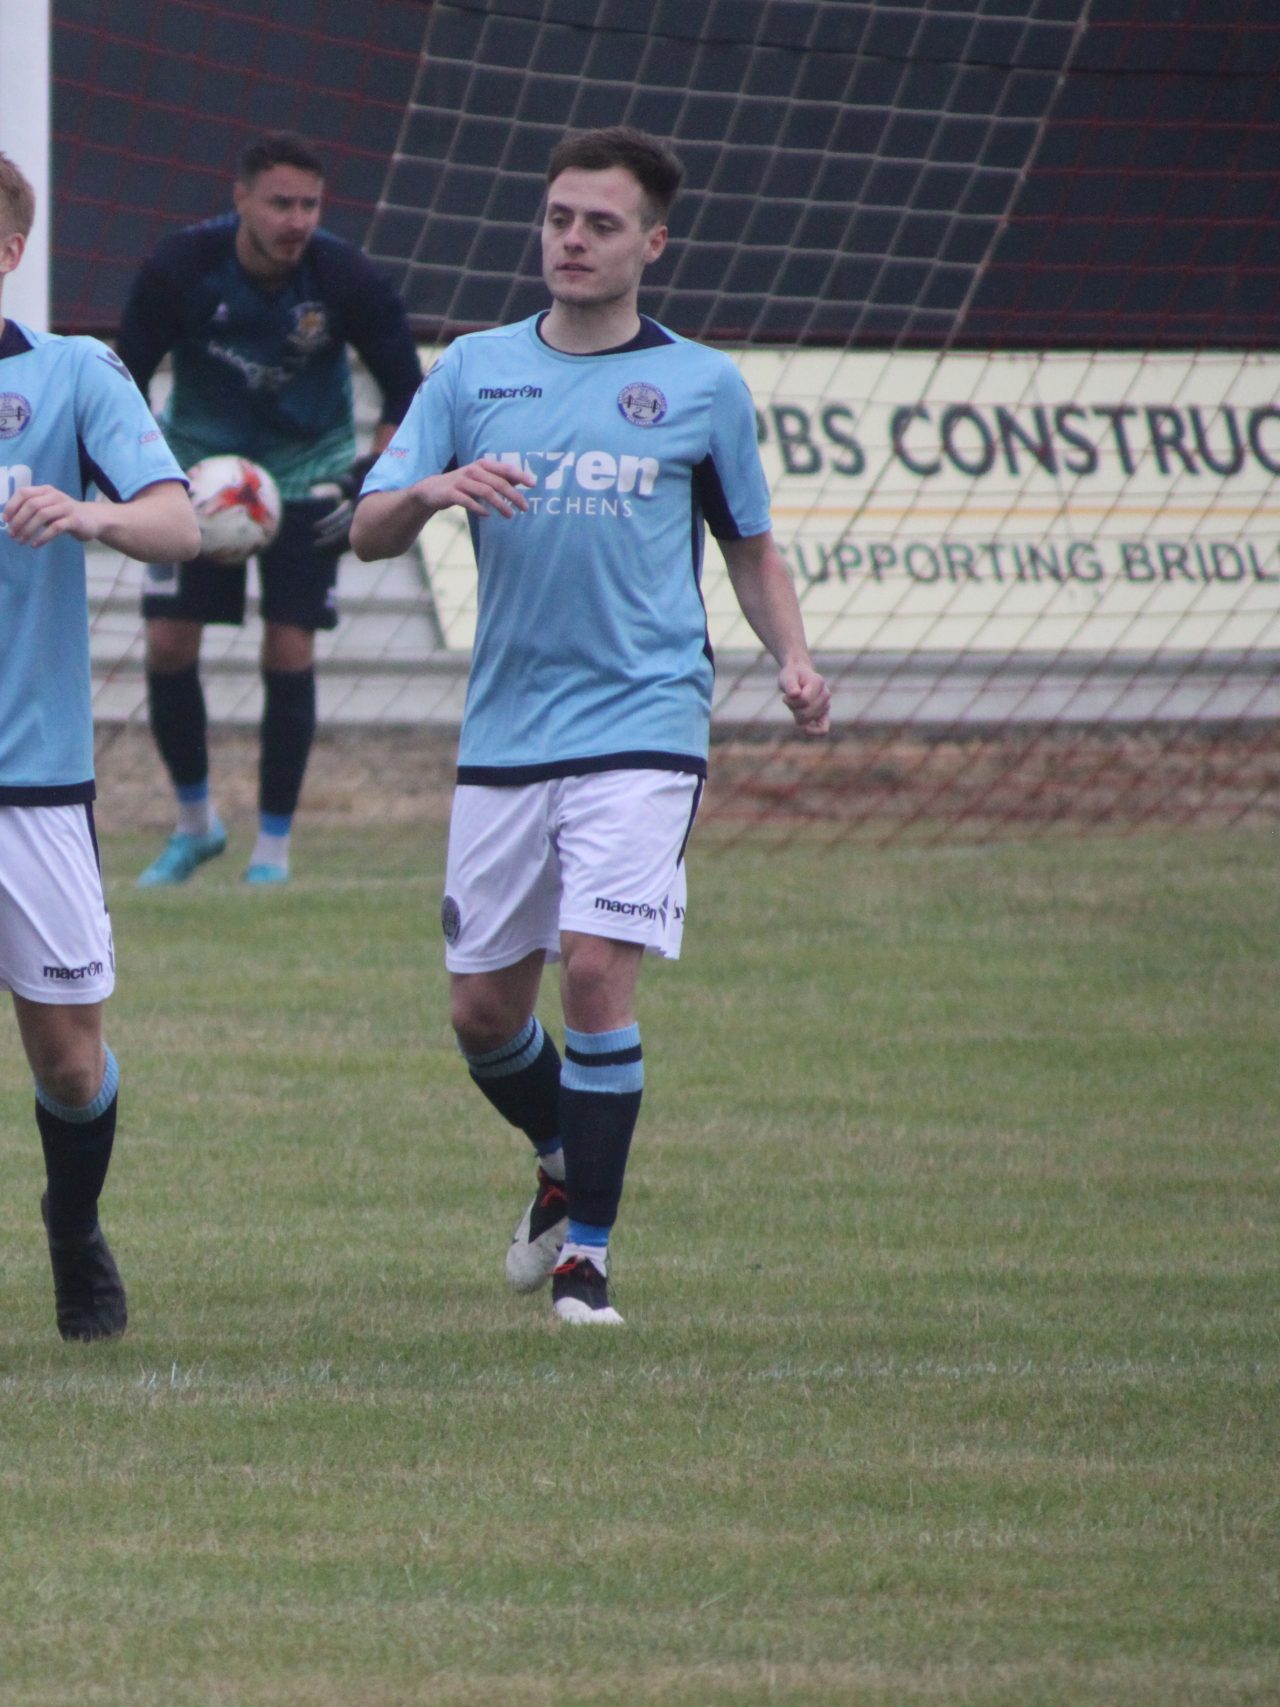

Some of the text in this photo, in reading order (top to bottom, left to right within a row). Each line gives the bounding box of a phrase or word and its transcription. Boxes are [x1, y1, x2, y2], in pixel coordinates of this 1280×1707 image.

[478, 385, 543, 400] macron
[756, 404, 866, 477] BS
[504, 496, 634, 518] TCHENS
[43, 961, 103, 980] macron
